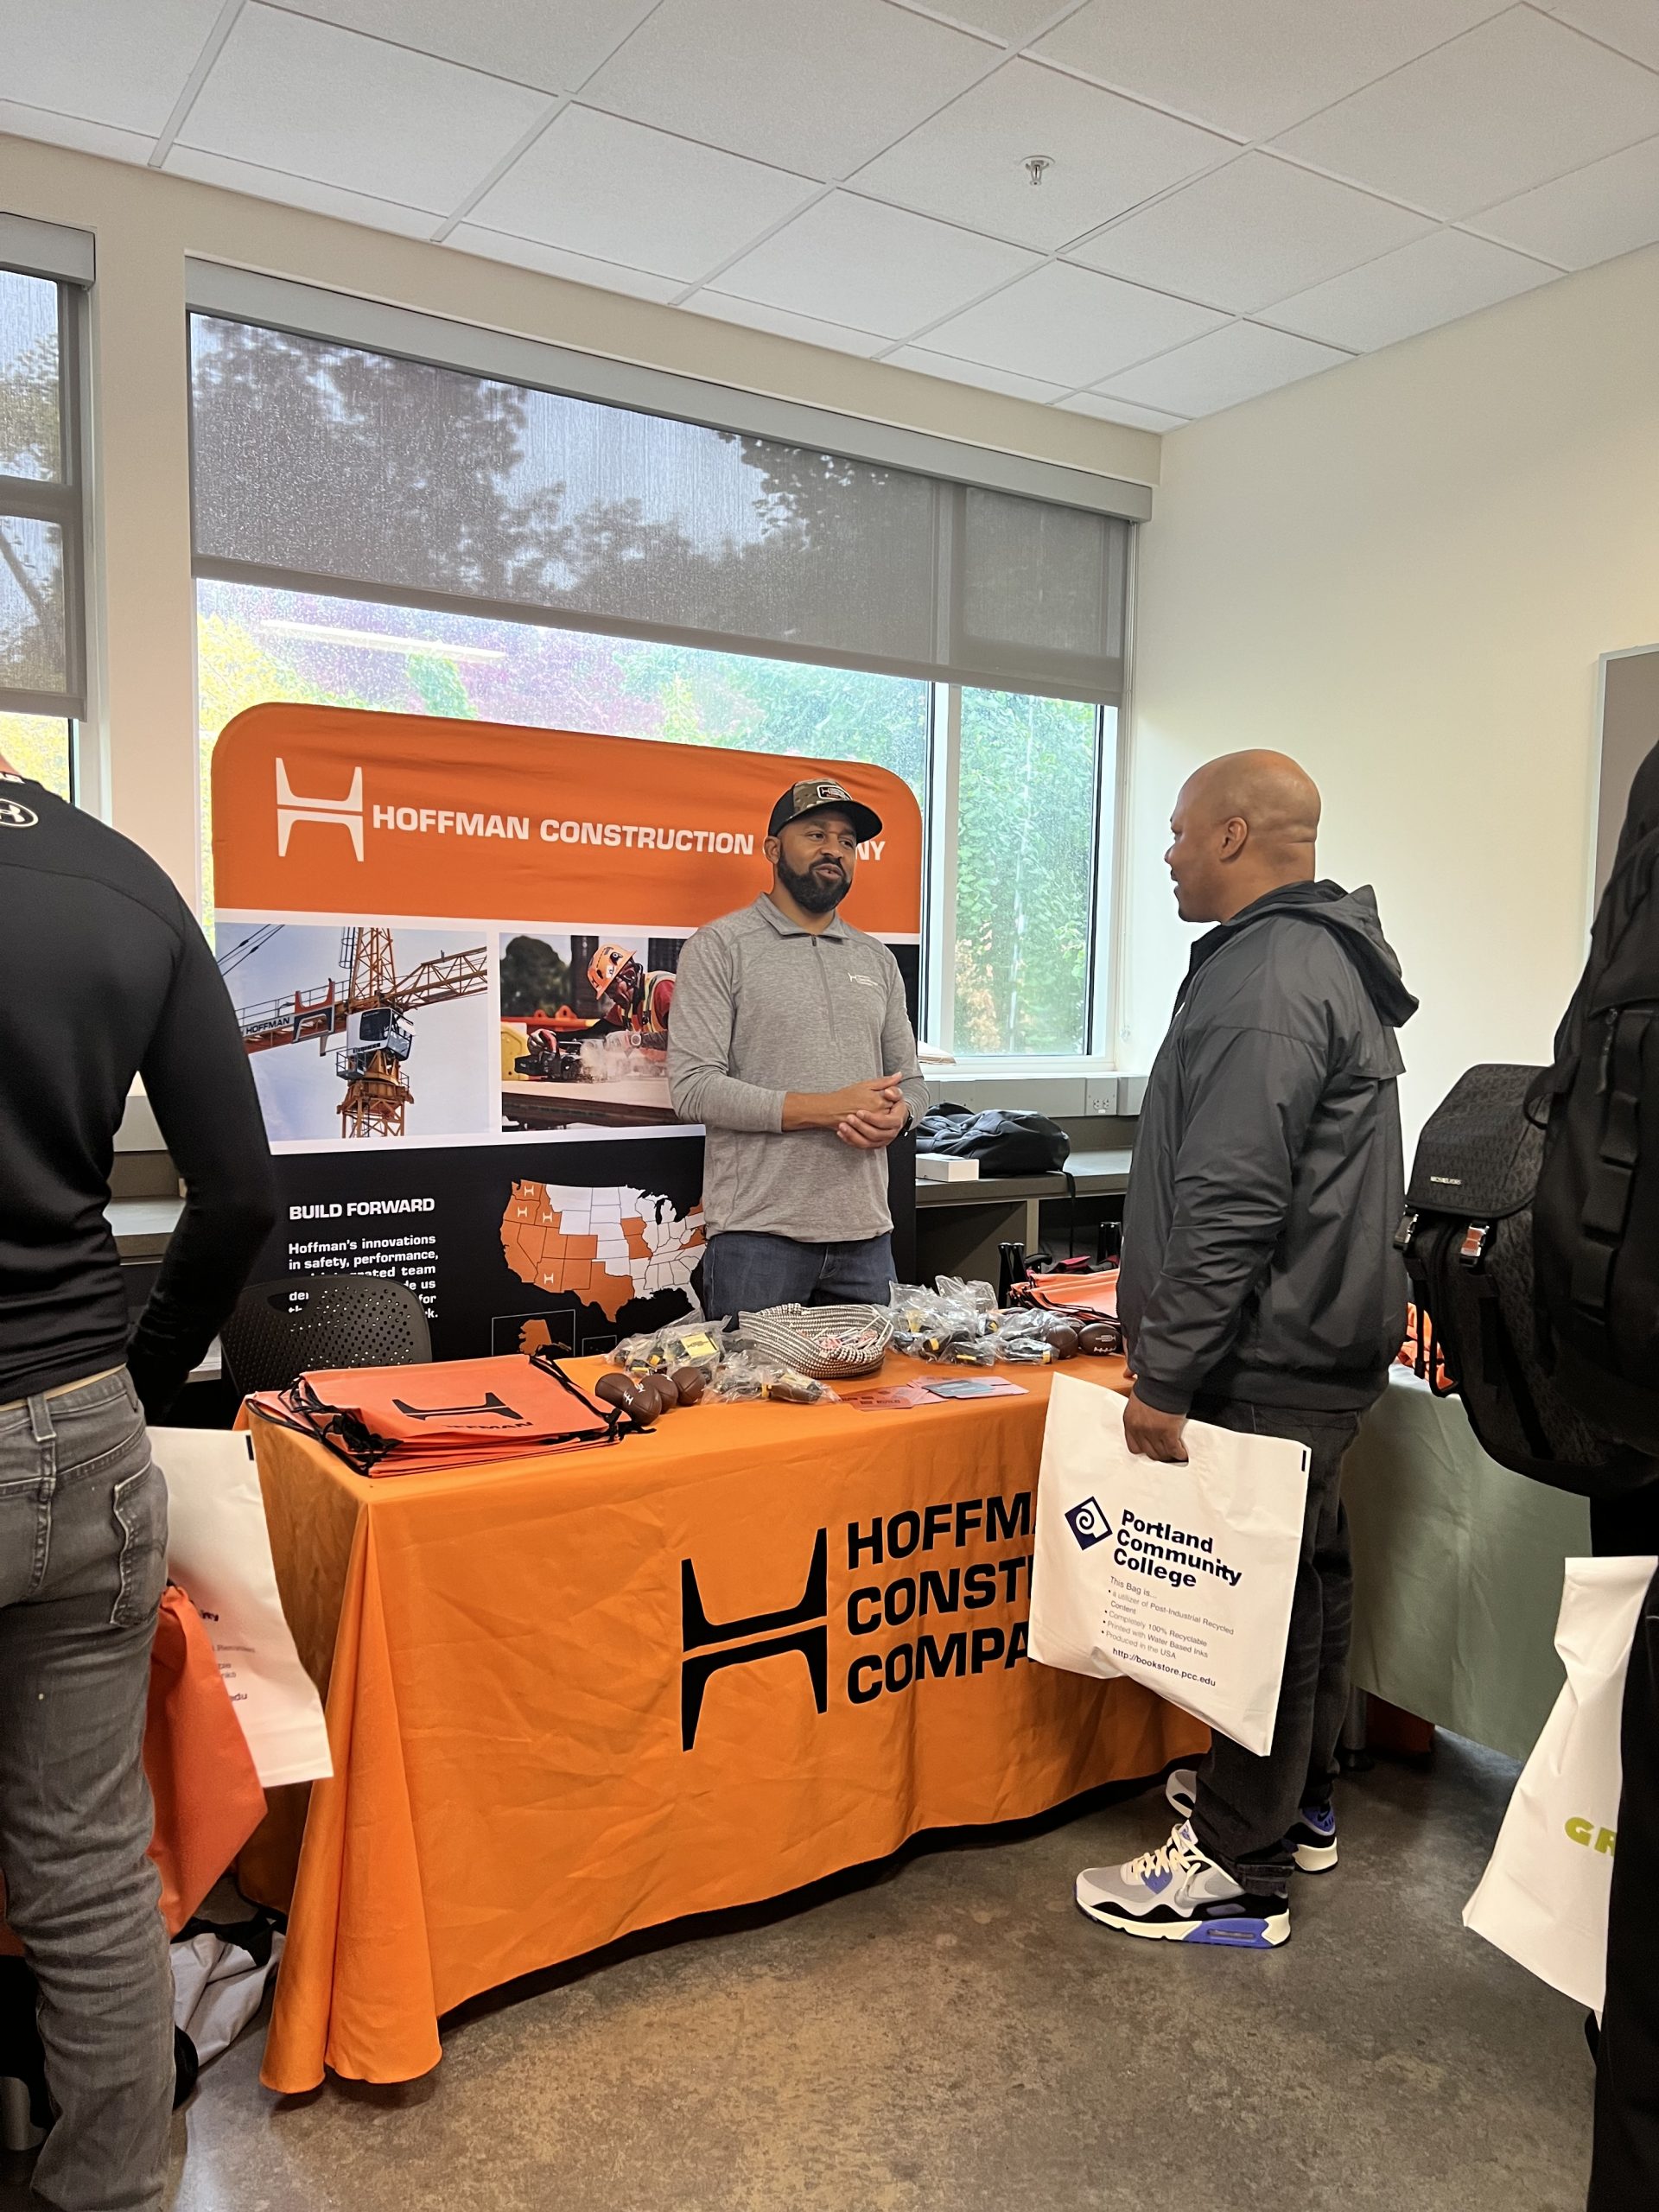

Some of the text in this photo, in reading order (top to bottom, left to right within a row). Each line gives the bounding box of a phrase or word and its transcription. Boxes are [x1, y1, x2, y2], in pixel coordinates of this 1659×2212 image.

[372, 804, 753, 855] HOFFMAN CONSTRUCTION
[245, 1017, 290, 1034] HOFFMAN
[289, 1198, 435, 1220] BUILD FORWARD
[289, 1235, 436, 1254] Hoffman's innovations
[289, 1249, 439, 1270] in safety, performance,
[401, 1265, 435, 1276] team
[419, 1294, 437, 1304] for
[421, 1280, 435, 1289] us
[848, 1491, 1036, 1570] HOFFM
[1122, 1509, 1213, 1554] Portland
[1114, 1548, 1197, 1588] College
[1117, 1529, 1242, 1586] Community
[1109, 1576, 1124, 1588] This
[1126, 1582, 1141, 1595] Bag
[1110, 1600, 1136, 1615] Content
[1118, 1592, 1140, 1605] utilizer
[1150, 1603, 1201, 1624] Post-Industrial
[1203, 1618, 1234, 1635] Recycled
[1107, 1620, 1209, 1658] Printed with Water Based Inks
[1109, 1611, 1208, 1647] Completely 100% Recyclable
[1106, 1630, 1138, 1648] Produced
[1147, 1645, 1159, 1654] the
[1160, 1648, 1176, 1659] USA
[1112, 1648, 1217, 1687] http://bookstore.pcc.edu
